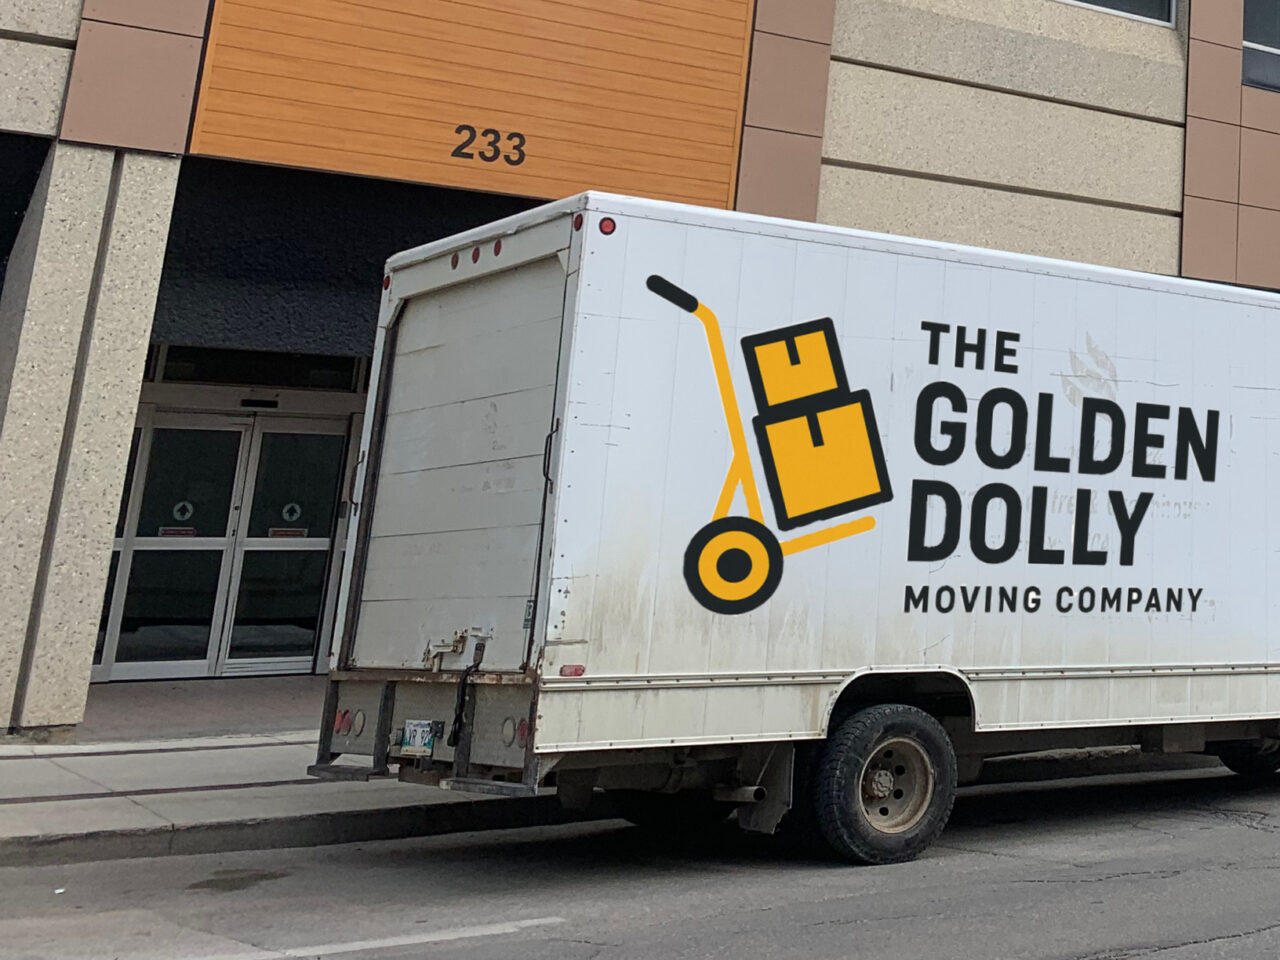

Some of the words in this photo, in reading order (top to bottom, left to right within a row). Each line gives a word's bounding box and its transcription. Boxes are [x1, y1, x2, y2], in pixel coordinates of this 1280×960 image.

[451, 124, 526, 166] 233
[920, 320, 1020, 374] THE
[914, 381, 1220, 482] GOLDEN
[907, 479, 1154, 566] DOLLY
[903, 585, 1042, 614] MOVING
[1055, 585, 1204, 614] COMPANY
